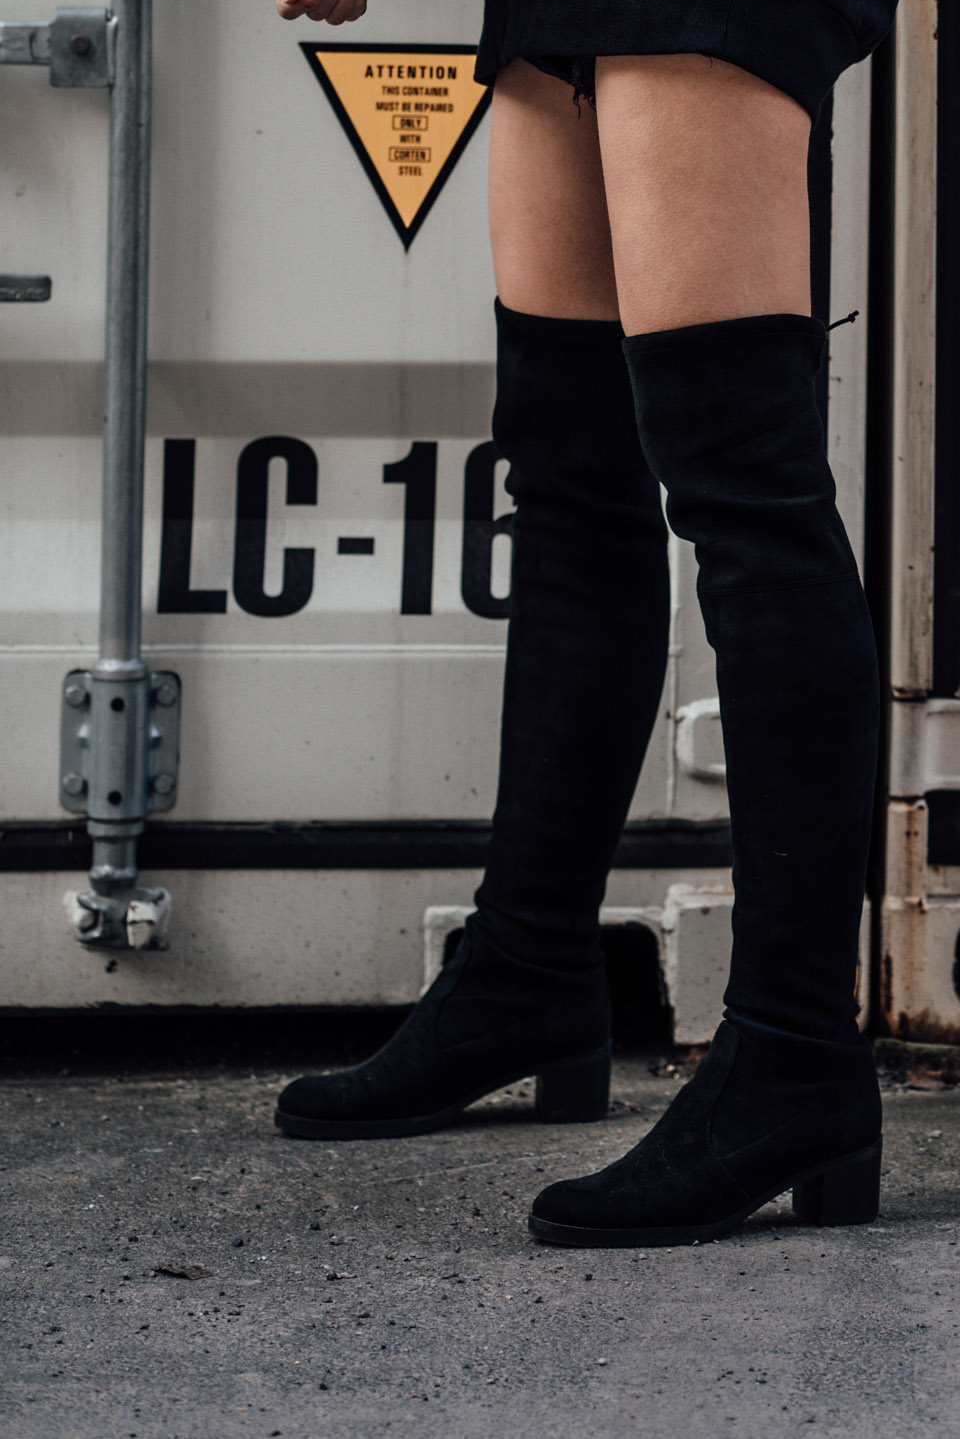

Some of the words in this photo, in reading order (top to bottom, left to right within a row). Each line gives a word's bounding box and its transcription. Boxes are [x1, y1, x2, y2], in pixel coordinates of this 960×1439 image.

[364, 65, 457, 80] ATTENTION
[381, 85, 400, 97] THIS
[402, 84, 449, 97] CONTAINER
[375, 101, 399, 113] MUST
[402, 101, 412, 113] BE
[414, 101, 454, 113] REPAIRED
[399, 117, 421, 128] ONLY
[399, 134, 421, 144] WITH
[393, 149, 427, 161] CORTEN
[398, 165, 422, 177] STEEL
